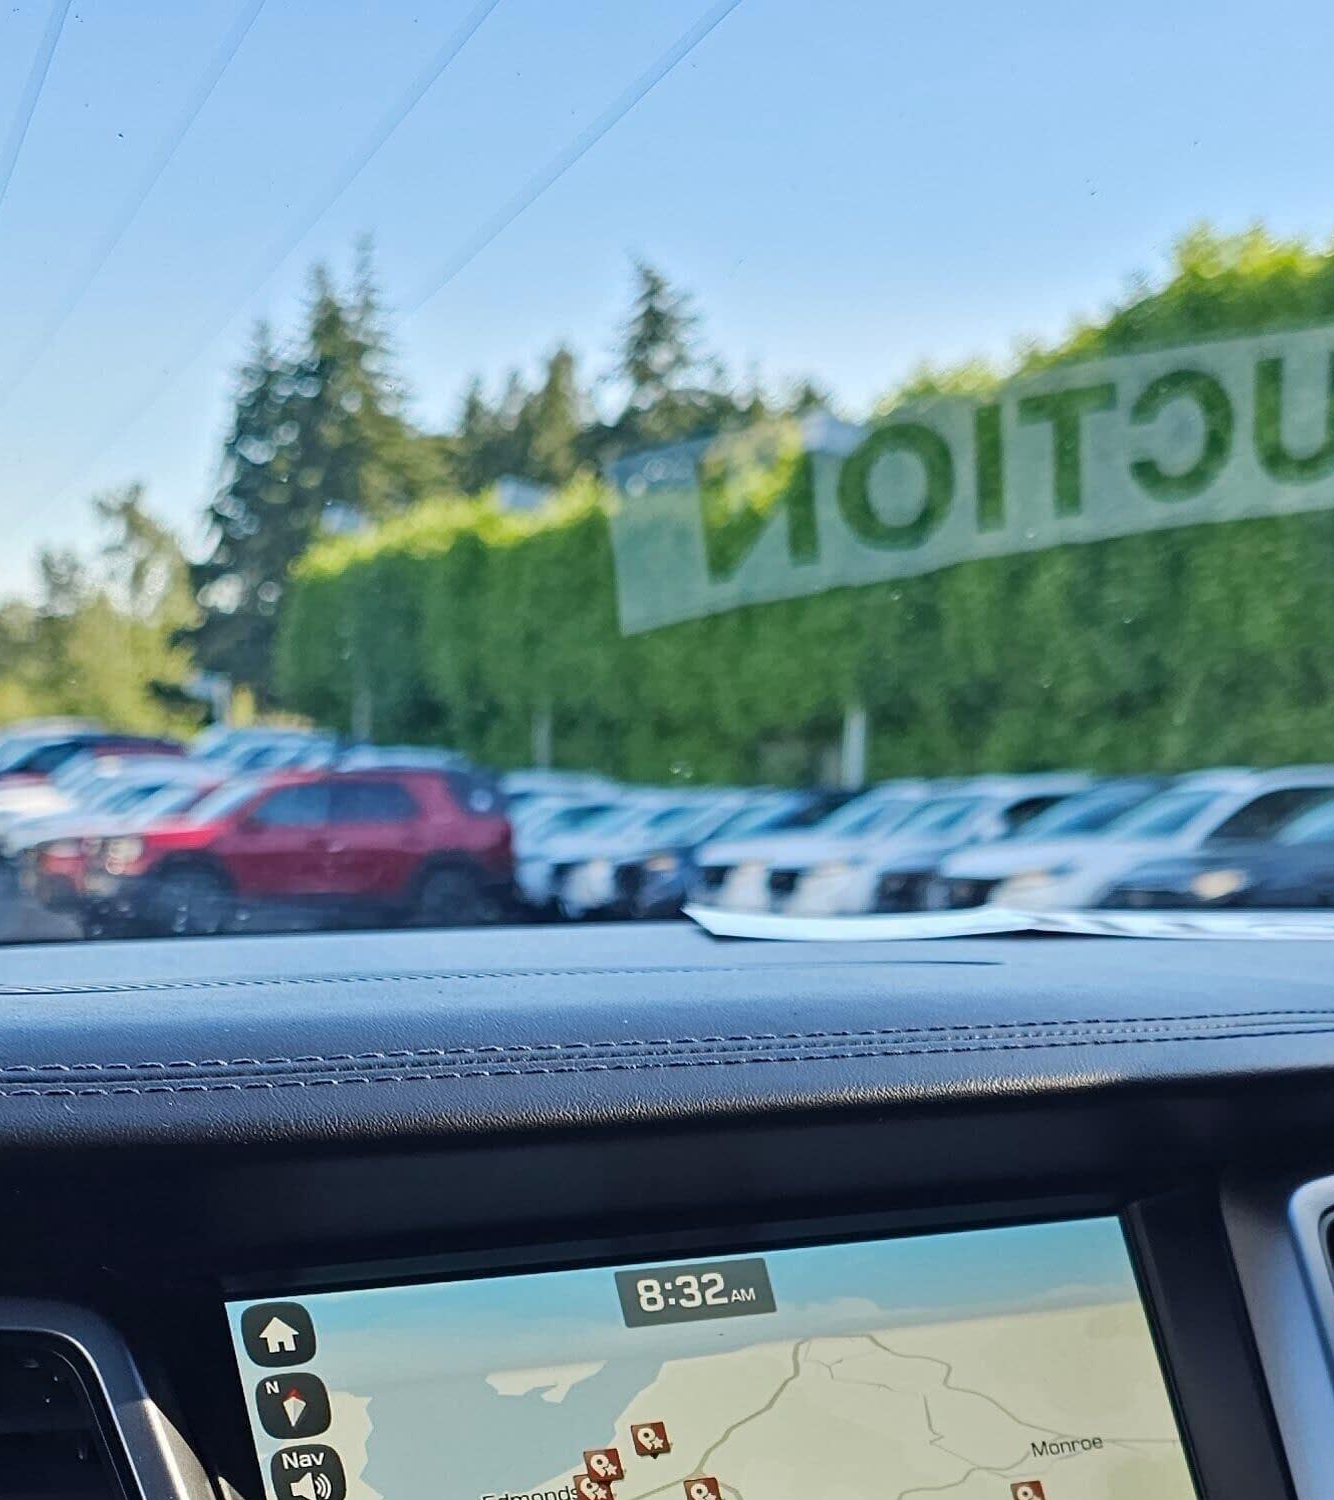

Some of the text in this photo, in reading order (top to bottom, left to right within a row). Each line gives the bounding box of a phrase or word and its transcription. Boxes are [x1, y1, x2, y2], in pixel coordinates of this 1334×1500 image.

[636, 1272, 757, 1312] 8:32 AM
[264, 1381, 279, 1395] N
[1030, 1437, 1103, 1457] Monroe
[281, 1451, 325, 1470] Nav
